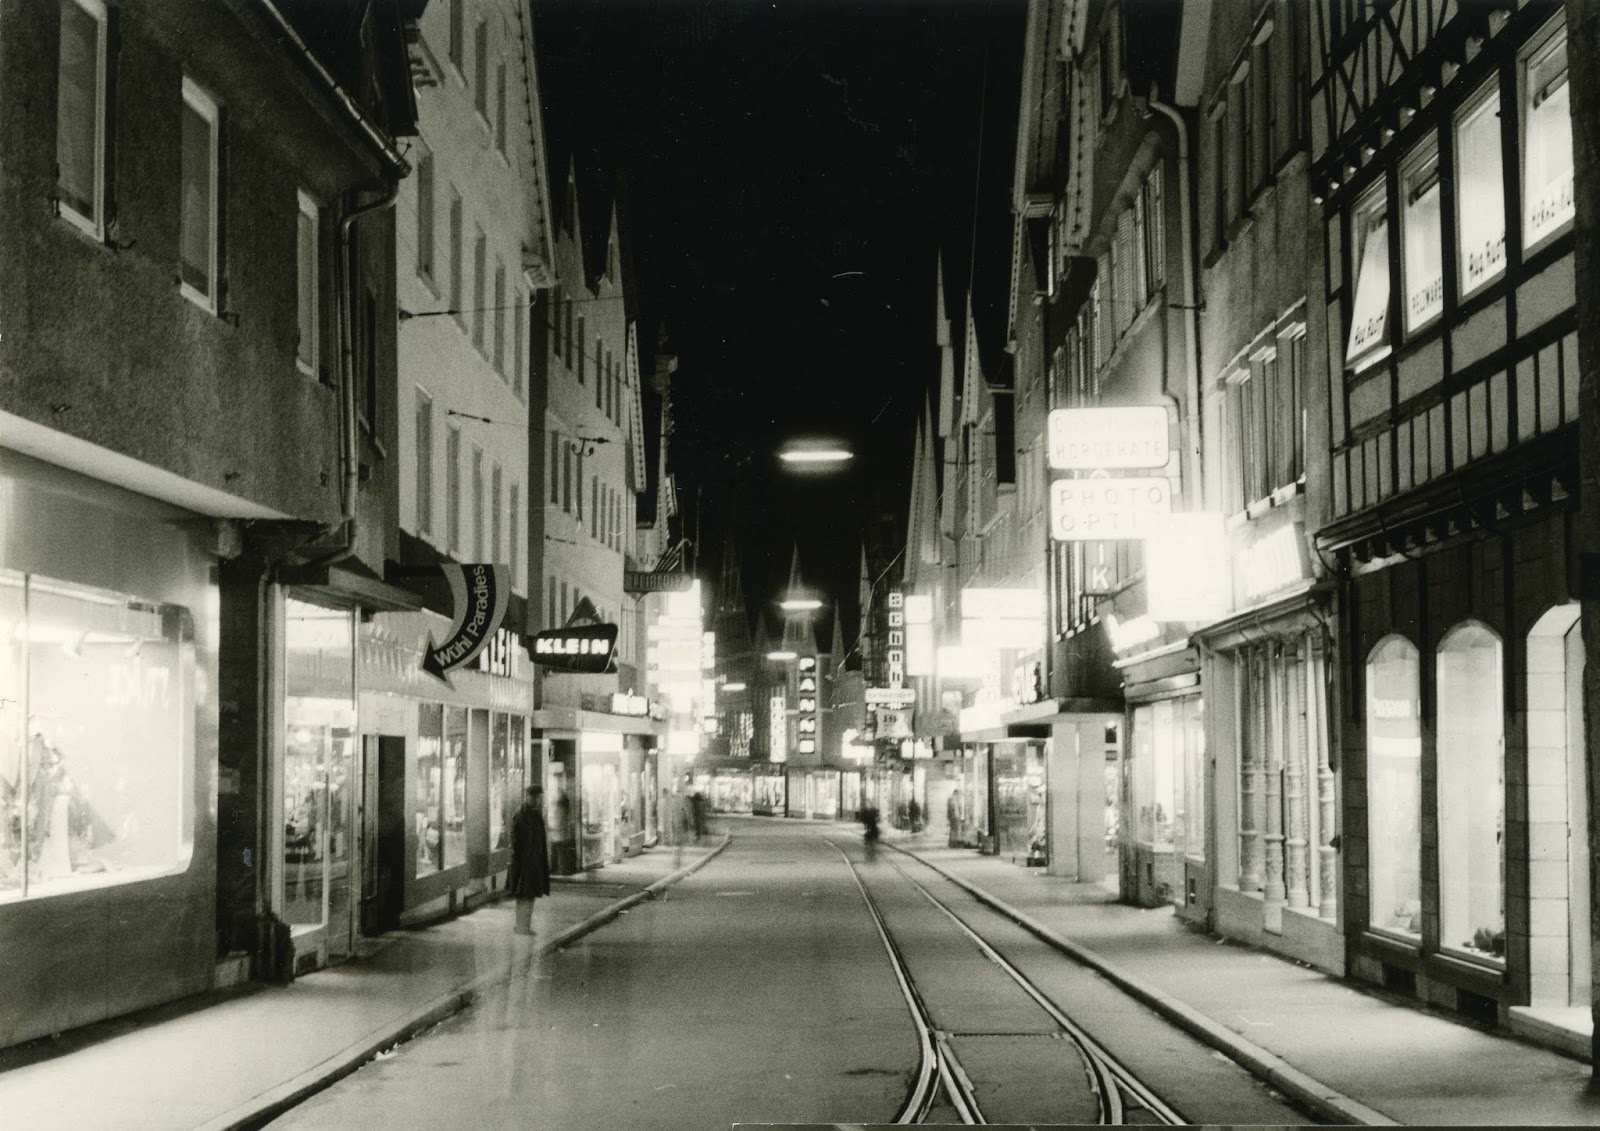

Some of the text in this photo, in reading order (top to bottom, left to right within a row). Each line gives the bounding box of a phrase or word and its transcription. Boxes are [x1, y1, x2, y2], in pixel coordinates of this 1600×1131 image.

[1061, 487, 1163, 507] PHOTO
[1061, 513, 1159, 532] OPTI
[434, 565, 489, 667] Wühl Paradies
[536, 638, 610, 655] KLEIN
